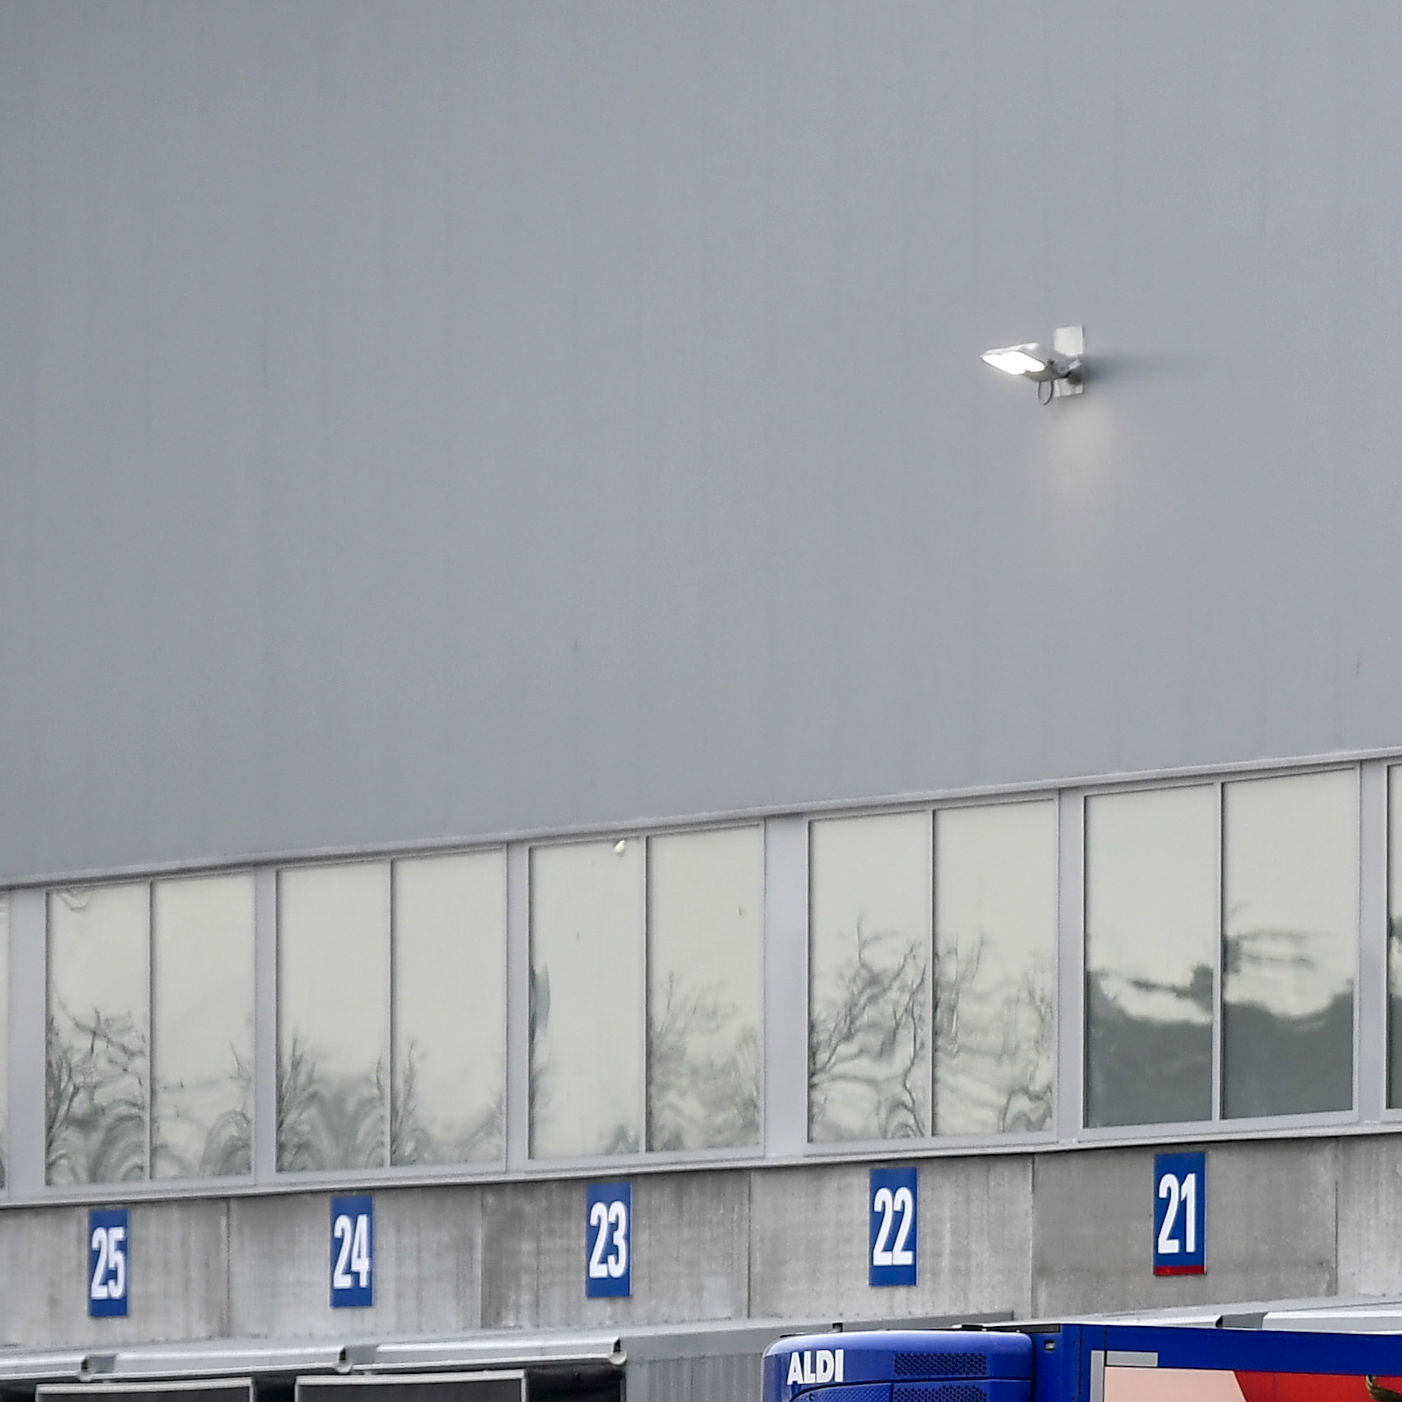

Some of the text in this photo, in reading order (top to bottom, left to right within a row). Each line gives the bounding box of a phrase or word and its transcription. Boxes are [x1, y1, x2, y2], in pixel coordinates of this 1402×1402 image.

[333, 1214, 371, 1289] 24
[589, 1200, 628, 1279] 23
[872, 1186, 914, 1266] 22
[1157, 1173, 1196, 1254] 21
[90, 1226, 126, 1300] 25
[786, 1349, 845, 1386] ALDI
